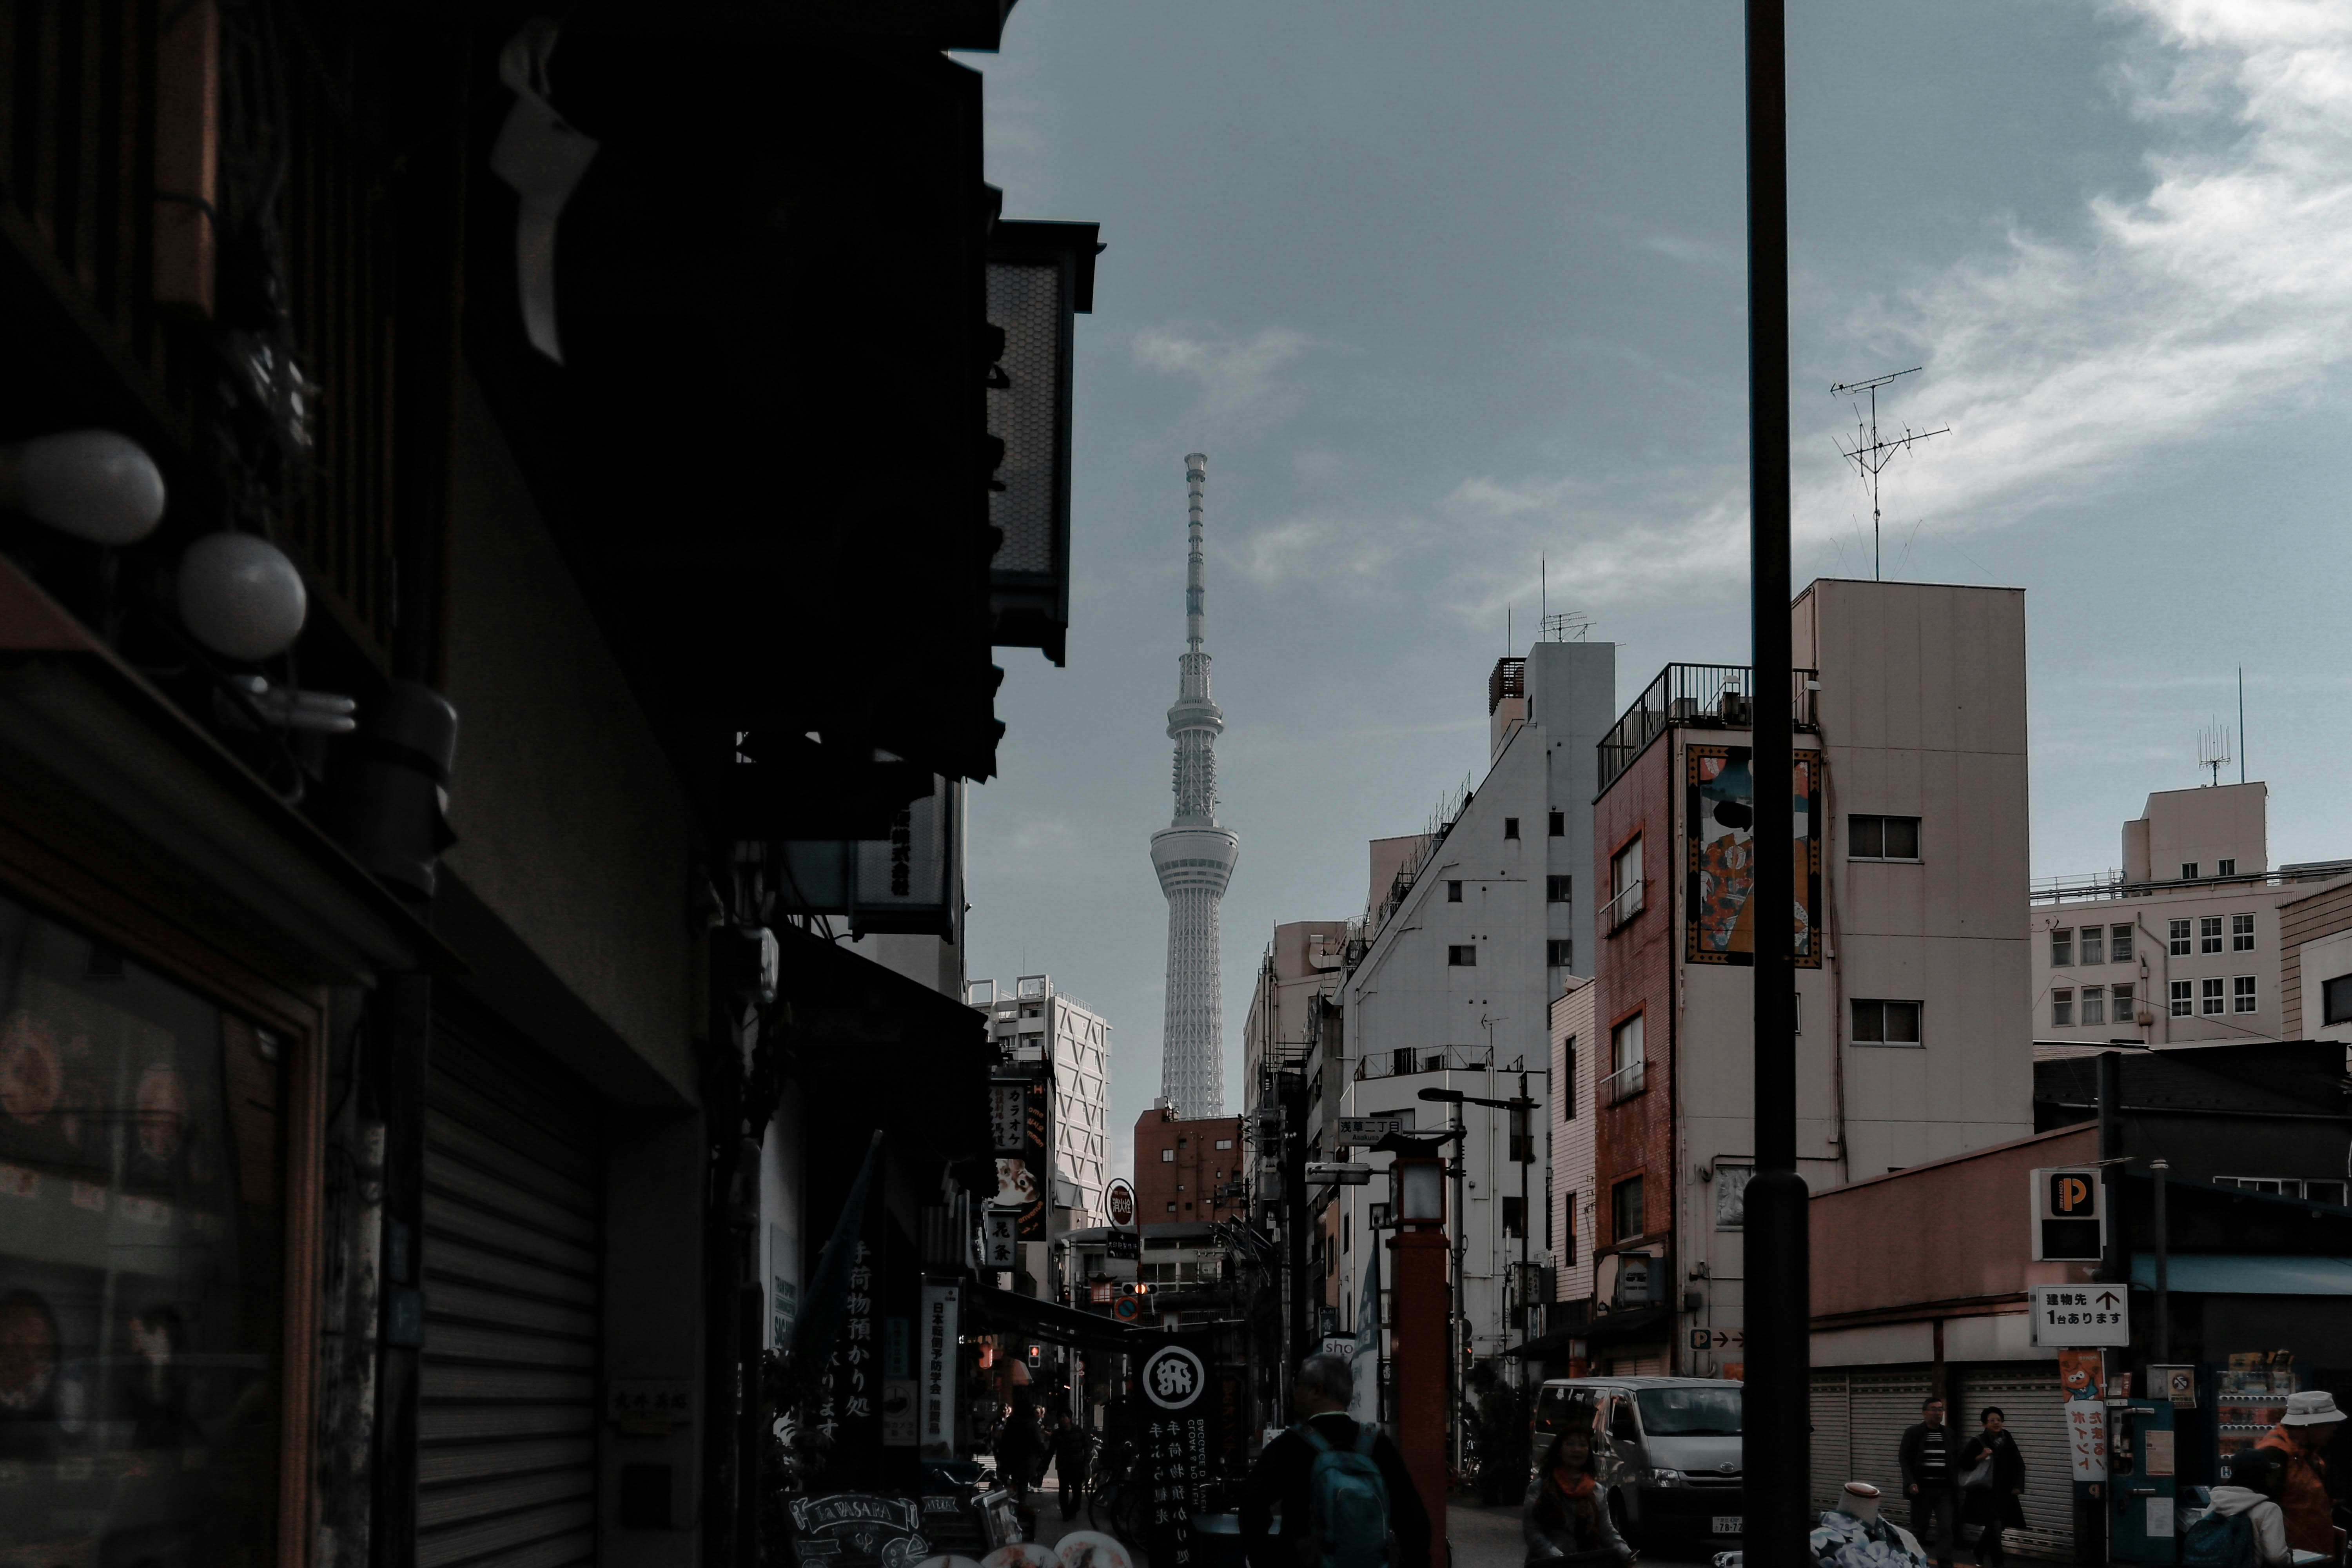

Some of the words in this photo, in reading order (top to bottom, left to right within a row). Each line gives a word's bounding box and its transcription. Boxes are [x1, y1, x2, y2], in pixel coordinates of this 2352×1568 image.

[1009, 1090, 1021, 1145] カラオケ
[1341, 1121, 1399, 1132] 浅草二丁目
[2063, 1178, 2087, 1211] P
[1112, 1198, 1131, 1214] 消火栓
[2046, 1293, 2087, 1306] 建物先
[2047, 1310, 2121, 1325] 1台あります
[846, 1240, 872, 1417] 手荷物預かり処
[931, 1302, 944, 1394] 日本転倒予防学会
[1694, 1331, 1708, 1347] P
[834, 1501, 892, 1521] VASARA
